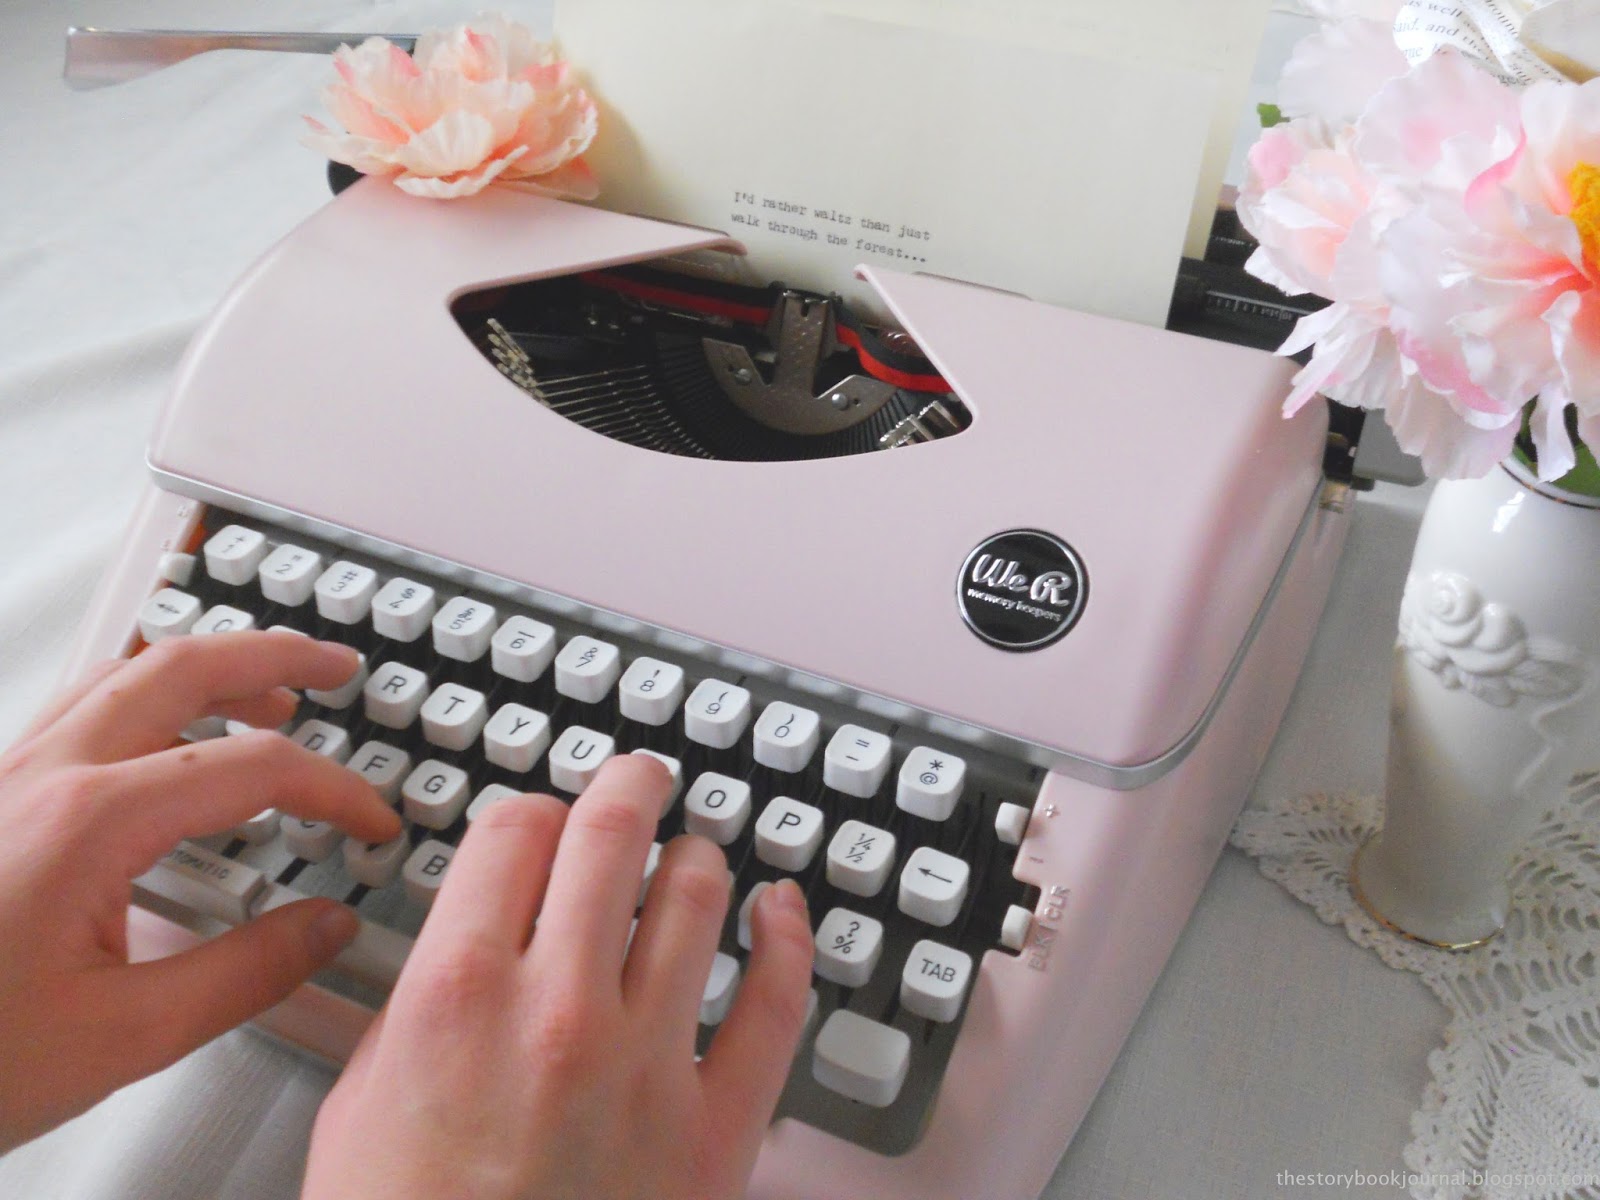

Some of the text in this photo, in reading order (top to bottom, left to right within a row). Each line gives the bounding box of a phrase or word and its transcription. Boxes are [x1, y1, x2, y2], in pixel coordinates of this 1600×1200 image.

[1425, 23, 1460, 37] and
[734, 191, 930, 242] I'd rather waltz than just
[731, 212, 927, 263] walk through the forest...
[275, 563, 292, 575] 2
[330, 581, 346, 593] 3
[972, 554, 1072, 607] We R
[967, 588, 1061, 623] memory keepers
[449, 618, 466, 631] 5
[509, 638, 526, 650] 6
[382, 675, 407, 694] R
[639, 679, 655, 692] 8
[443, 696, 466, 715] T
[705, 702, 721, 715] 9
[508, 717, 531, 736] Y
[570, 739, 596, 760] U
[362, 754, 390, 772] F
[423, 774, 447, 794] G
[919, 771, 939, 786] @
[775, 811, 801, 830] P
[421, 855, 448, 877] B
[846, 921, 861, 939] ?
[832, 935, 854, 955] %
[919, 957, 957, 983] TAB
